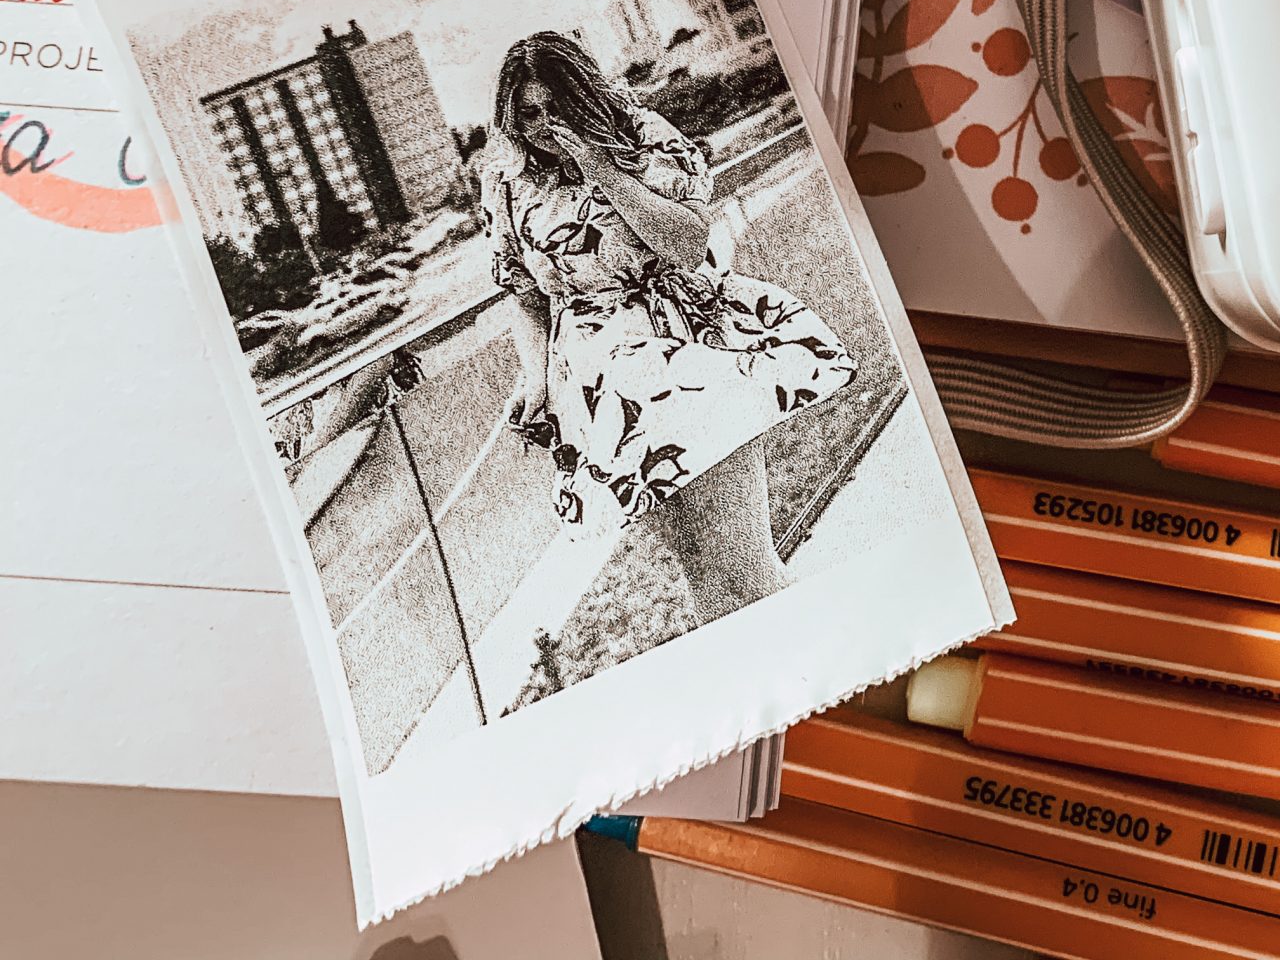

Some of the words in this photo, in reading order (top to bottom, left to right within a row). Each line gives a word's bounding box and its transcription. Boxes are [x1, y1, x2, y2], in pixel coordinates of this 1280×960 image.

[1033, 492, 1125, 528] 105293
[1131, 507, 1219, 543] 006381
[1225, 524, 1241, 546] 4
[964, 776, 1057, 819] 333795
[1060, 799, 1150, 842] 006381
[1155, 822, 1173, 846] 4
[1062, 877, 1099, 905] 0,4
[1107, 887, 1157, 920] fine
